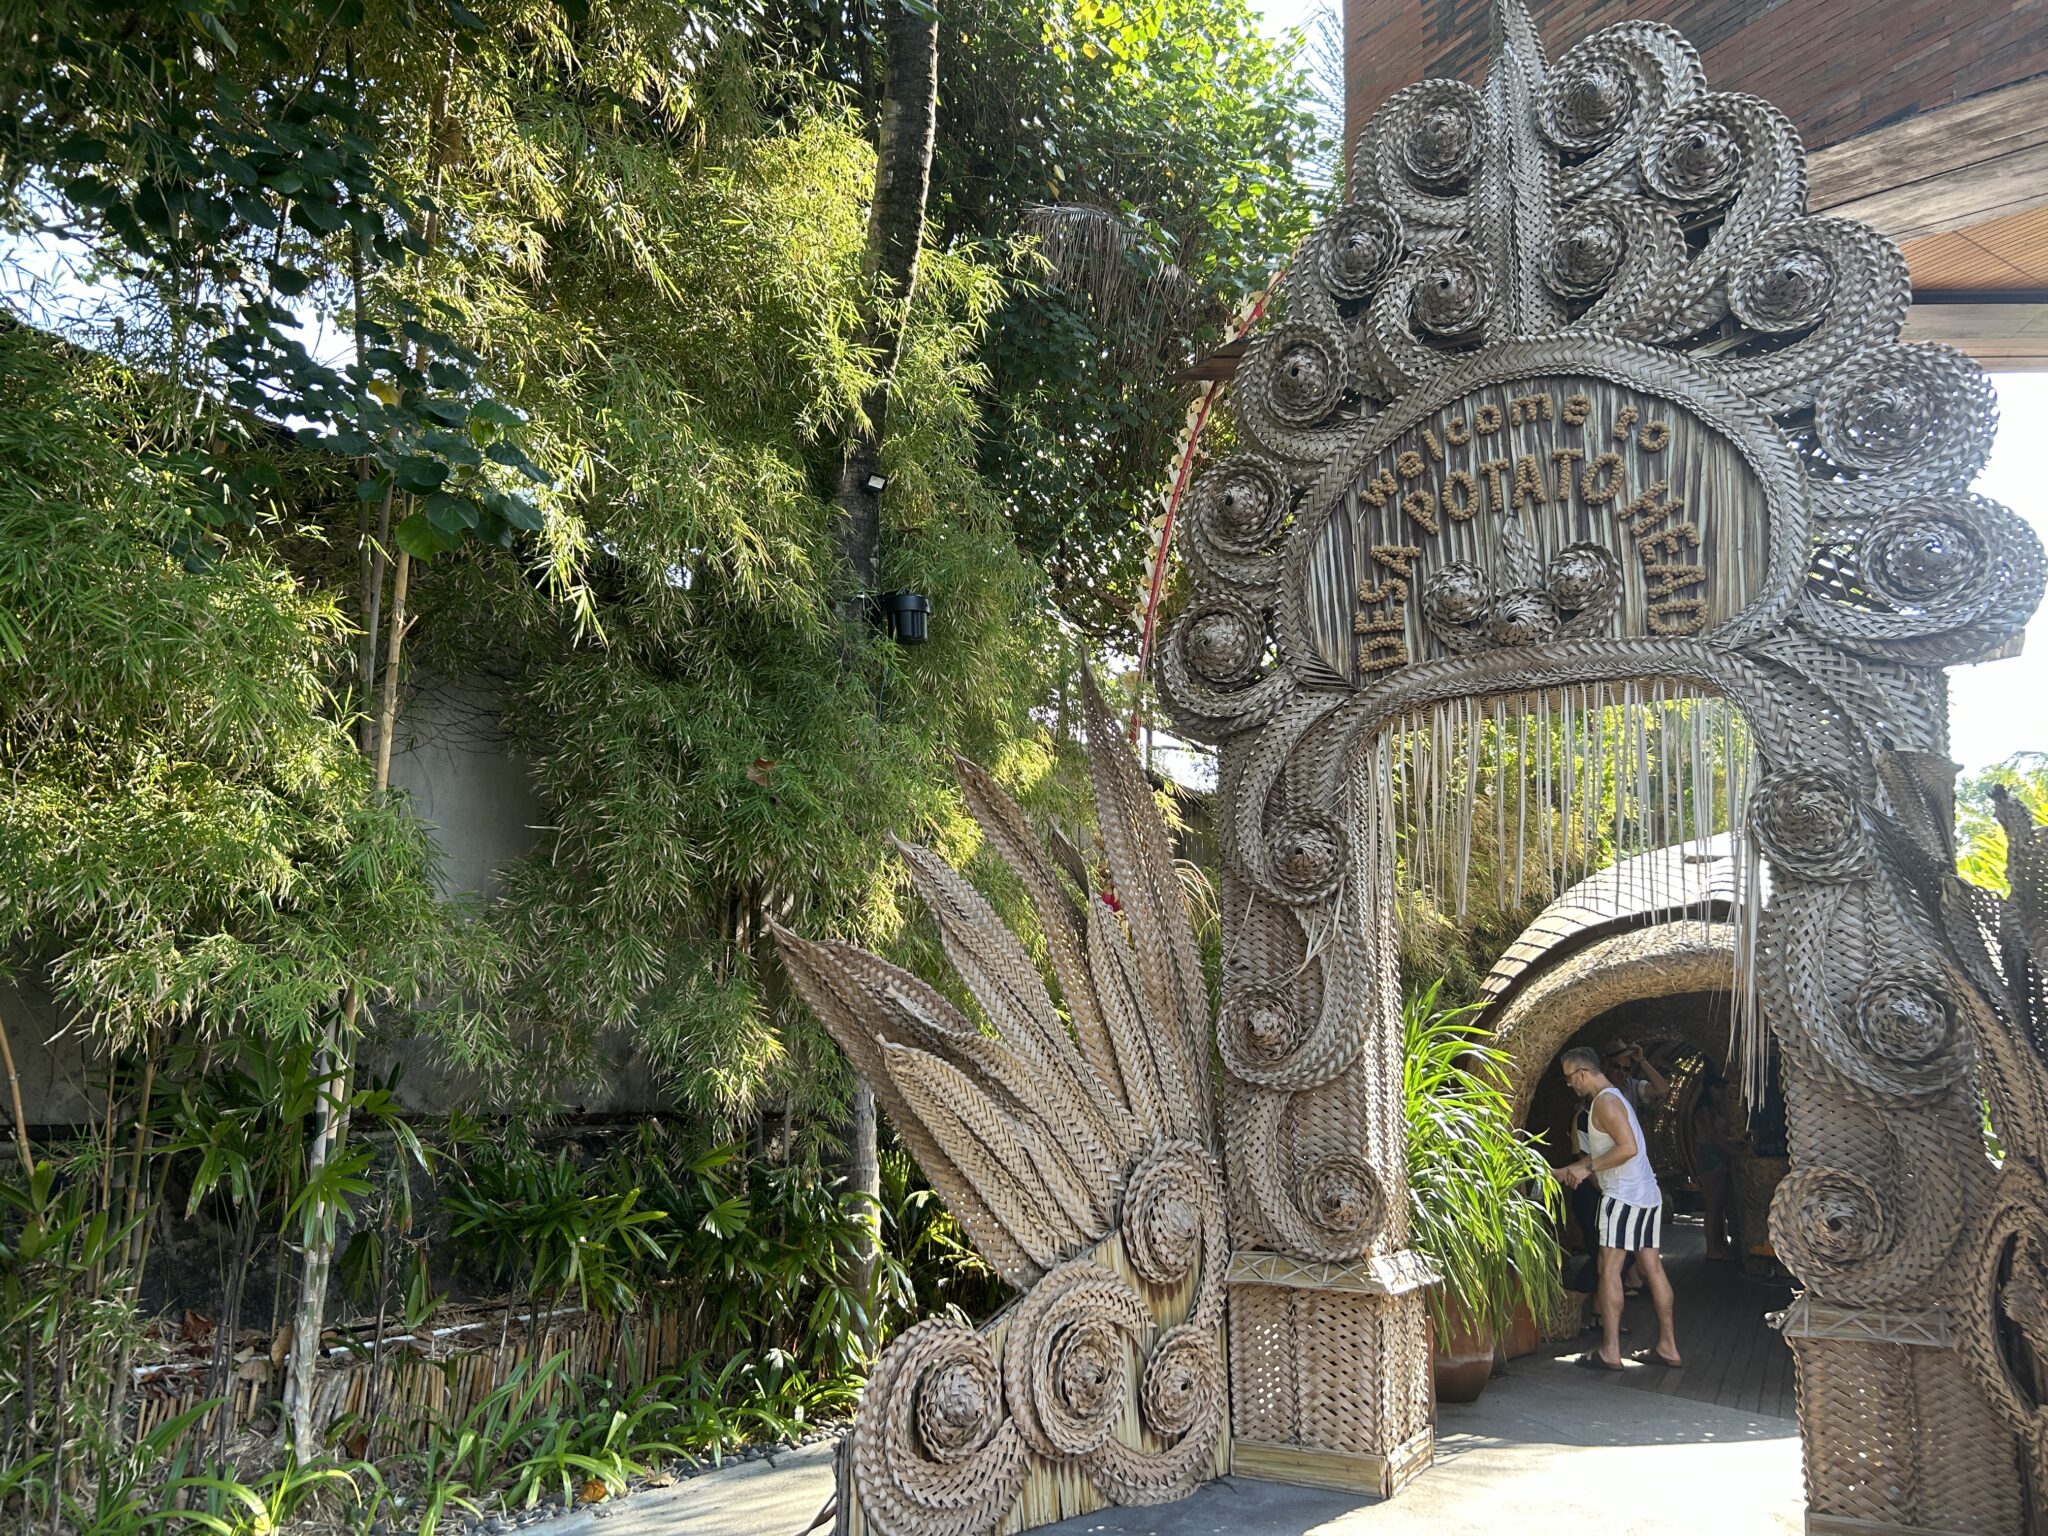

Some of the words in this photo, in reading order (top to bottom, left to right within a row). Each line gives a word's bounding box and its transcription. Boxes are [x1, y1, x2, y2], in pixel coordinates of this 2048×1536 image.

[1614, 405, 1671, 452] to
[1354, 545, 1421, 673] DESA
[1402, 447, 1625, 536] POTATO
[1619, 479, 1708, 636] HEAD
